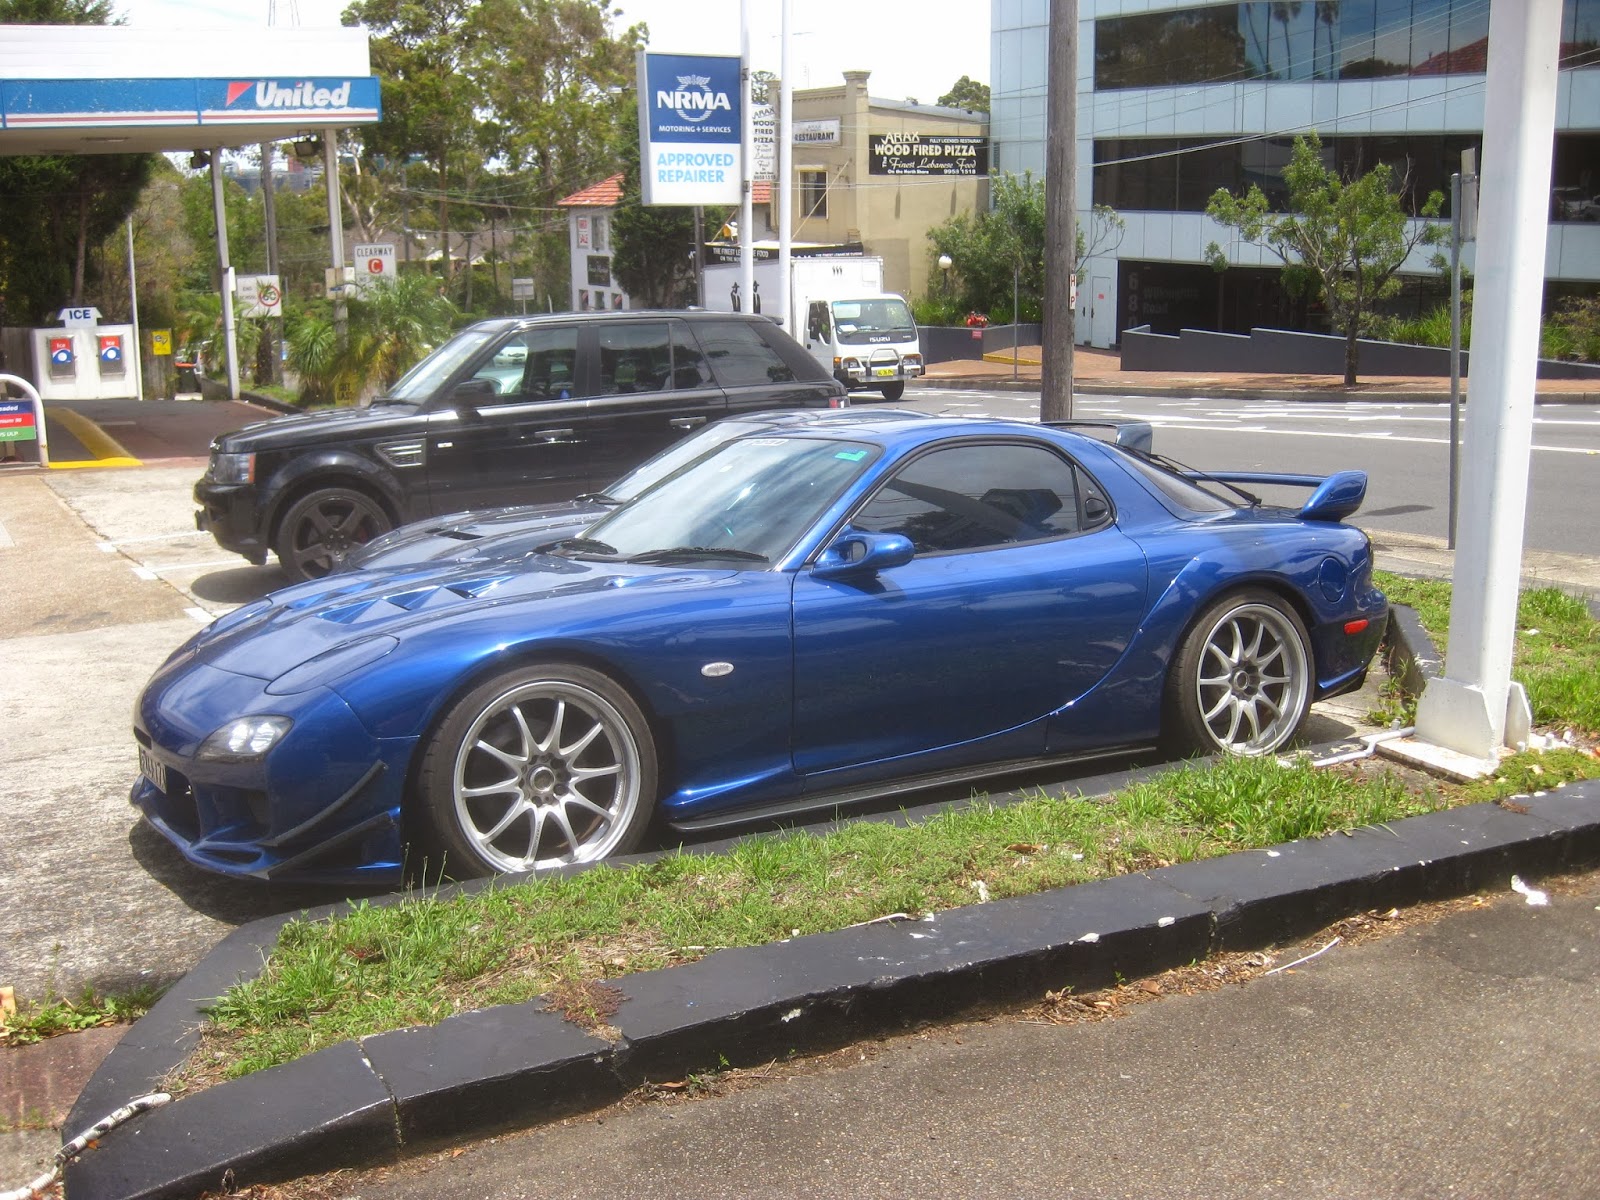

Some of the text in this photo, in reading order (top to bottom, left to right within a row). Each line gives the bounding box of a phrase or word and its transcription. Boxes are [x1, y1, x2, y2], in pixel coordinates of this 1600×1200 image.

[255, 80, 351, 107] United
[656, 91, 731, 110] NRMA
[795, 132, 834, 141] RESTAURANT
[881, 131, 920, 144] ARAX
[875, 144, 976, 156] WOOD FIRED PIZZA
[657, 153, 734, 167] APPROVED
[889, 157, 915, 169] Finest
[917, 157, 953, 168] Lebanese
[956, 158, 976, 170] Food
[658, 170, 725, 183] REPAIRER
[356, 248, 393, 256] CLEARWAY
[371, 260, 380, 272] C
[69, 310, 91, 319] ICE
